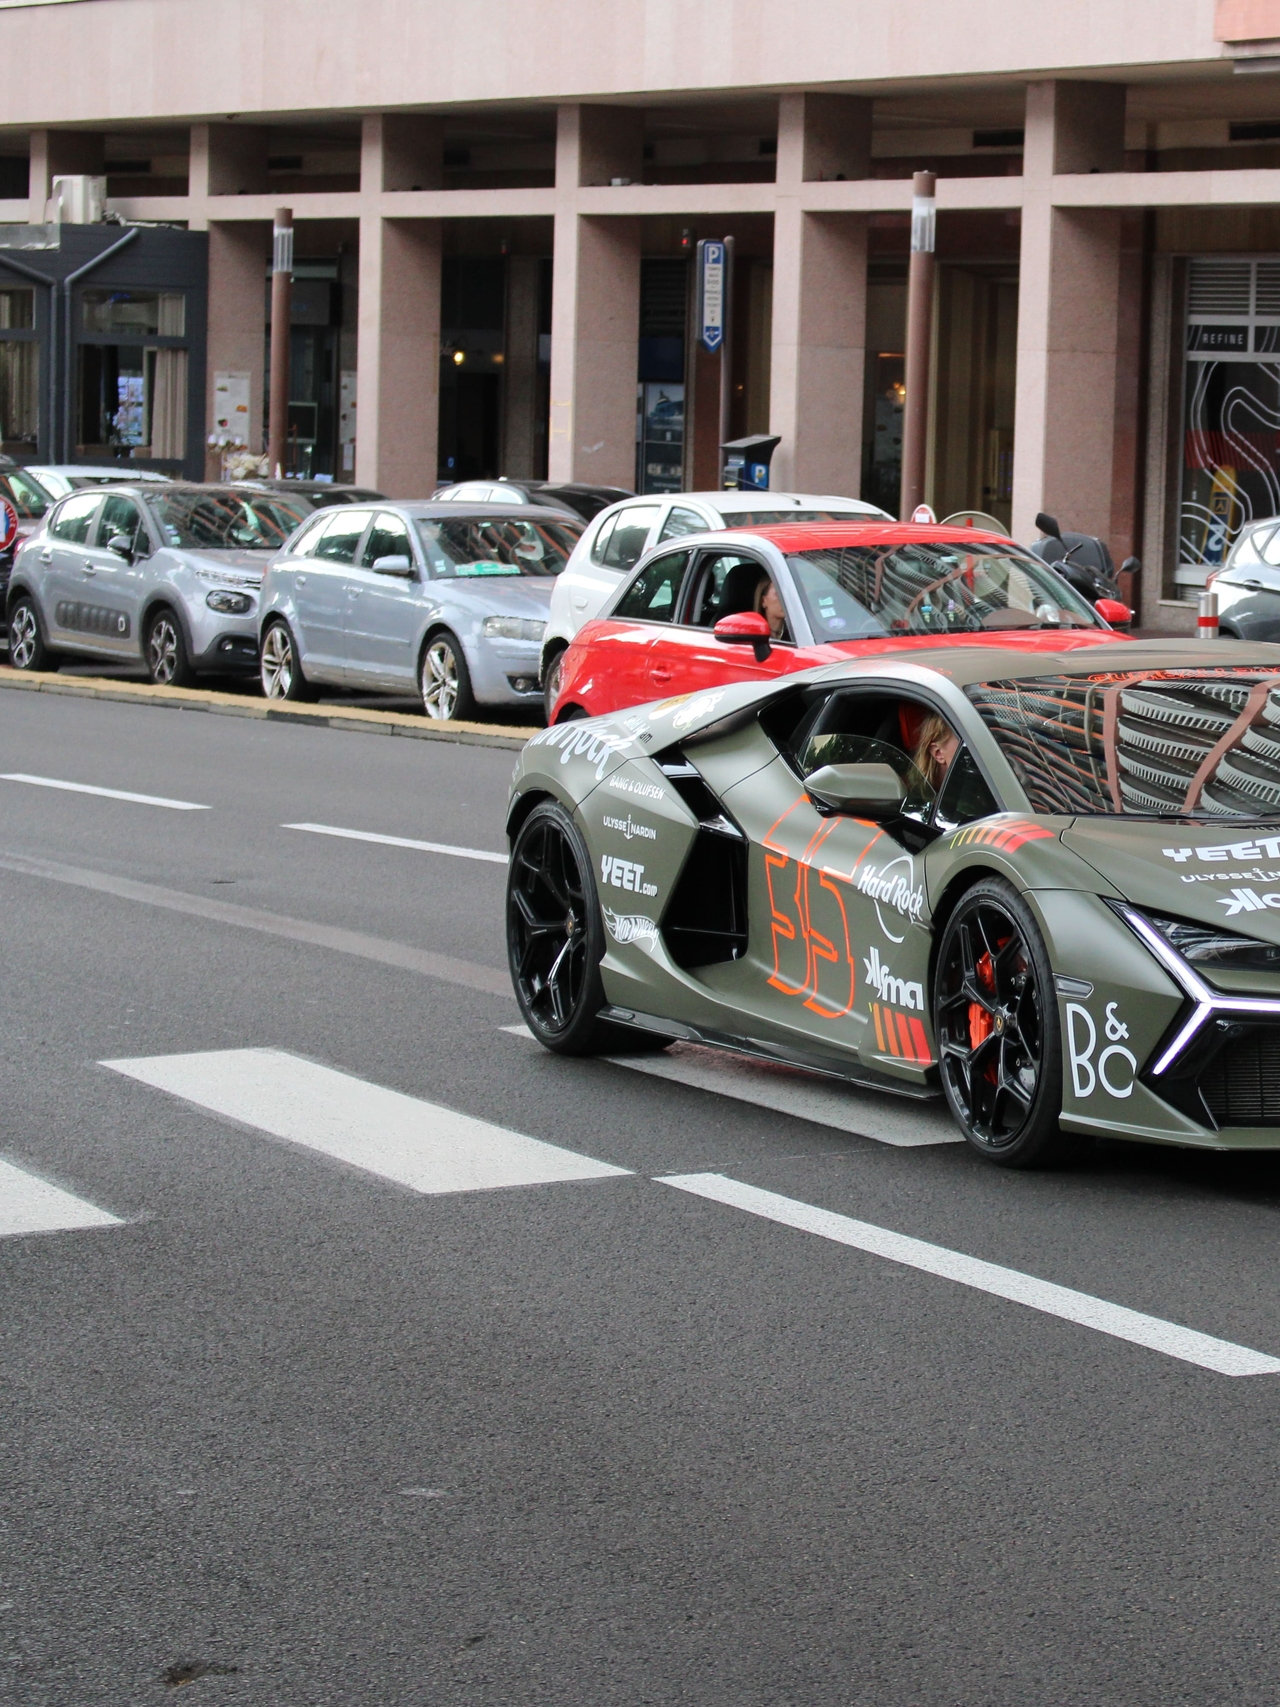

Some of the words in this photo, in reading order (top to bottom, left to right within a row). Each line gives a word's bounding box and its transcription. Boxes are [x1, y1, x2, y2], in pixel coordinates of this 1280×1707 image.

[1202, 333, 1244, 345] REFINE
[609, 774, 627, 791] BANG
[628, 780, 634, 792] &
[634, 781, 667, 800] OLUFSEN
[603, 815, 627, 832] ULYSSE
[631, 823, 657, 840] NARDIN
[601, 854, 658, 897] YEET.com
[1180, 872, 1252, 884] ULYSSE
[857, 863, 896, 905] Hard
[892, 875, 925, 922] Rock
